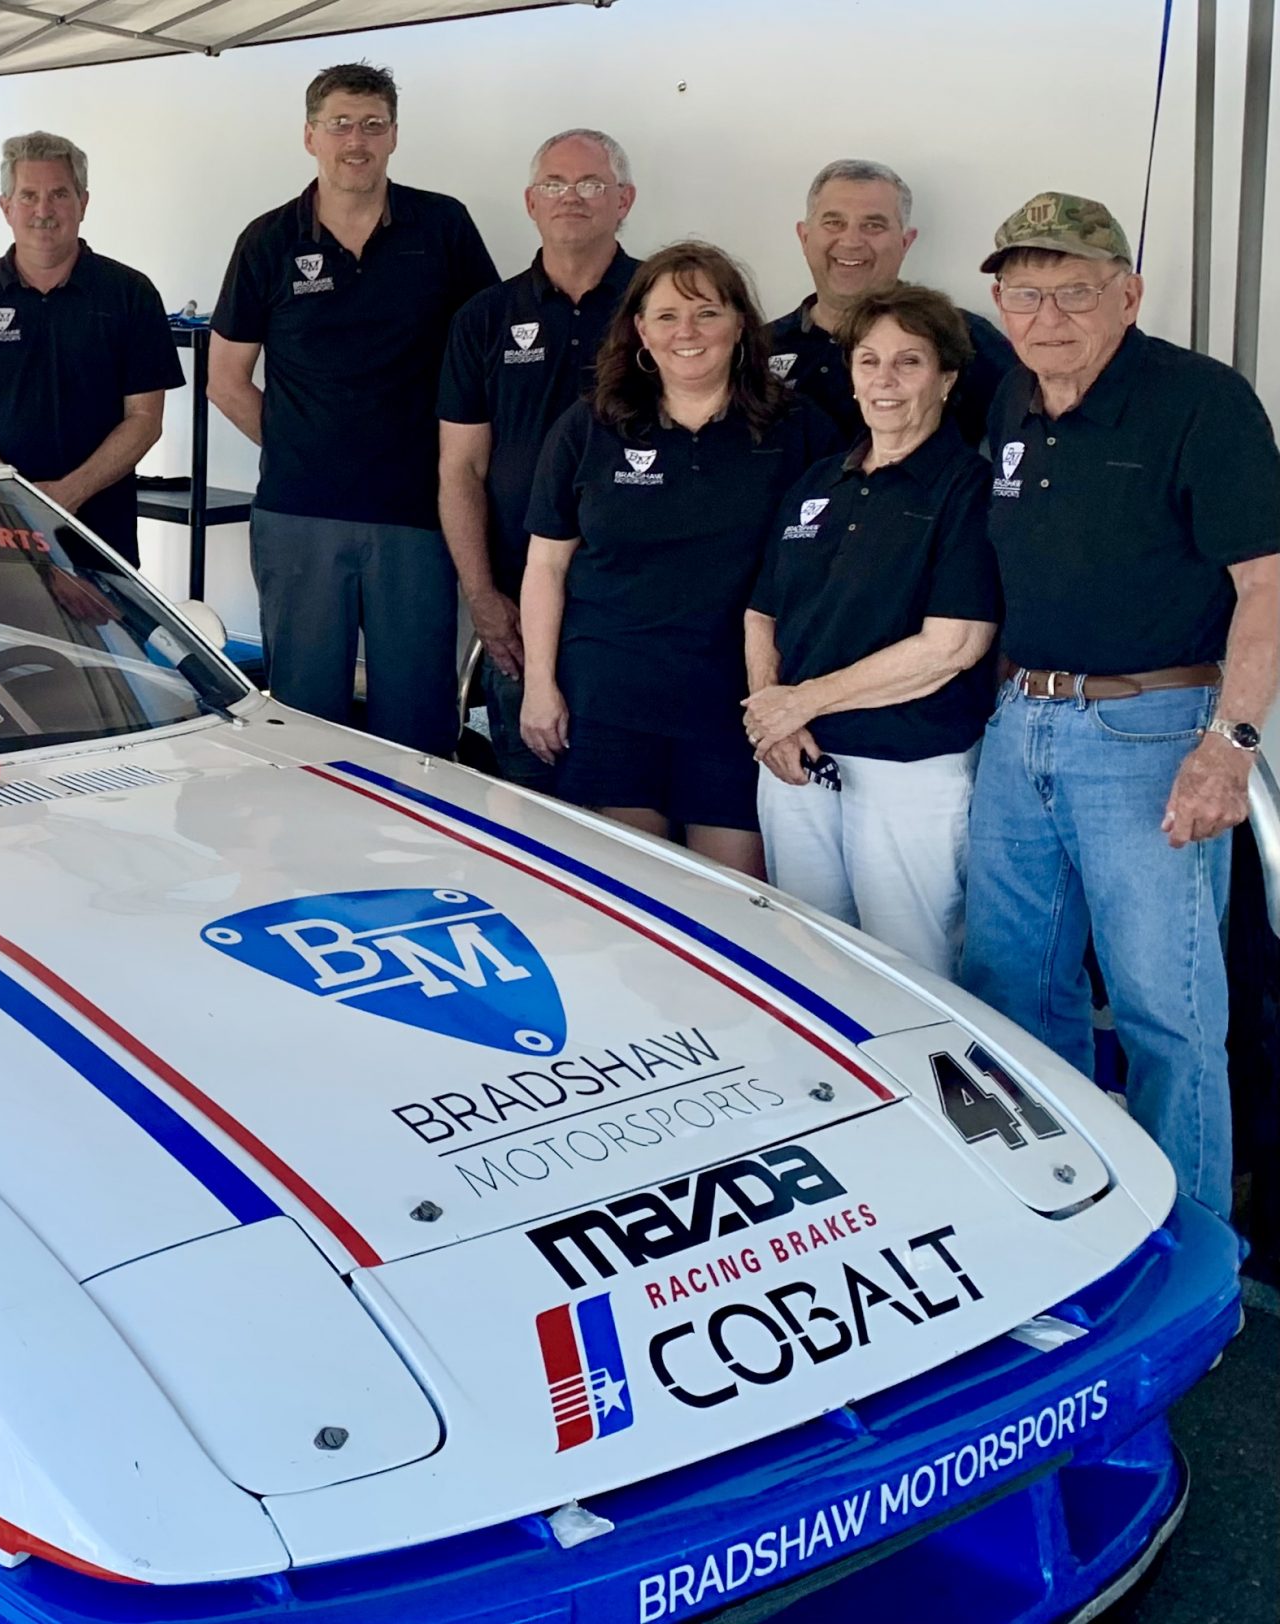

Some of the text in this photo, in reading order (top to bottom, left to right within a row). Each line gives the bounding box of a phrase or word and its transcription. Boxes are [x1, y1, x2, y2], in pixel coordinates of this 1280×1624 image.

[265, 918, 532, 998] BM
[391, 1027, 721, 1144] BRADSHAW
[455, 1078, 784, 1198] MOTORSPORTS
[928, 1040, 1067, 1150] 41
[645, 1203, 878, 1310] RACING BRAKES
[648, 1225, 985, 1409] COBALT
[638, 1380, 1108, 1623] BRADSHAW MOTORSPORTS
